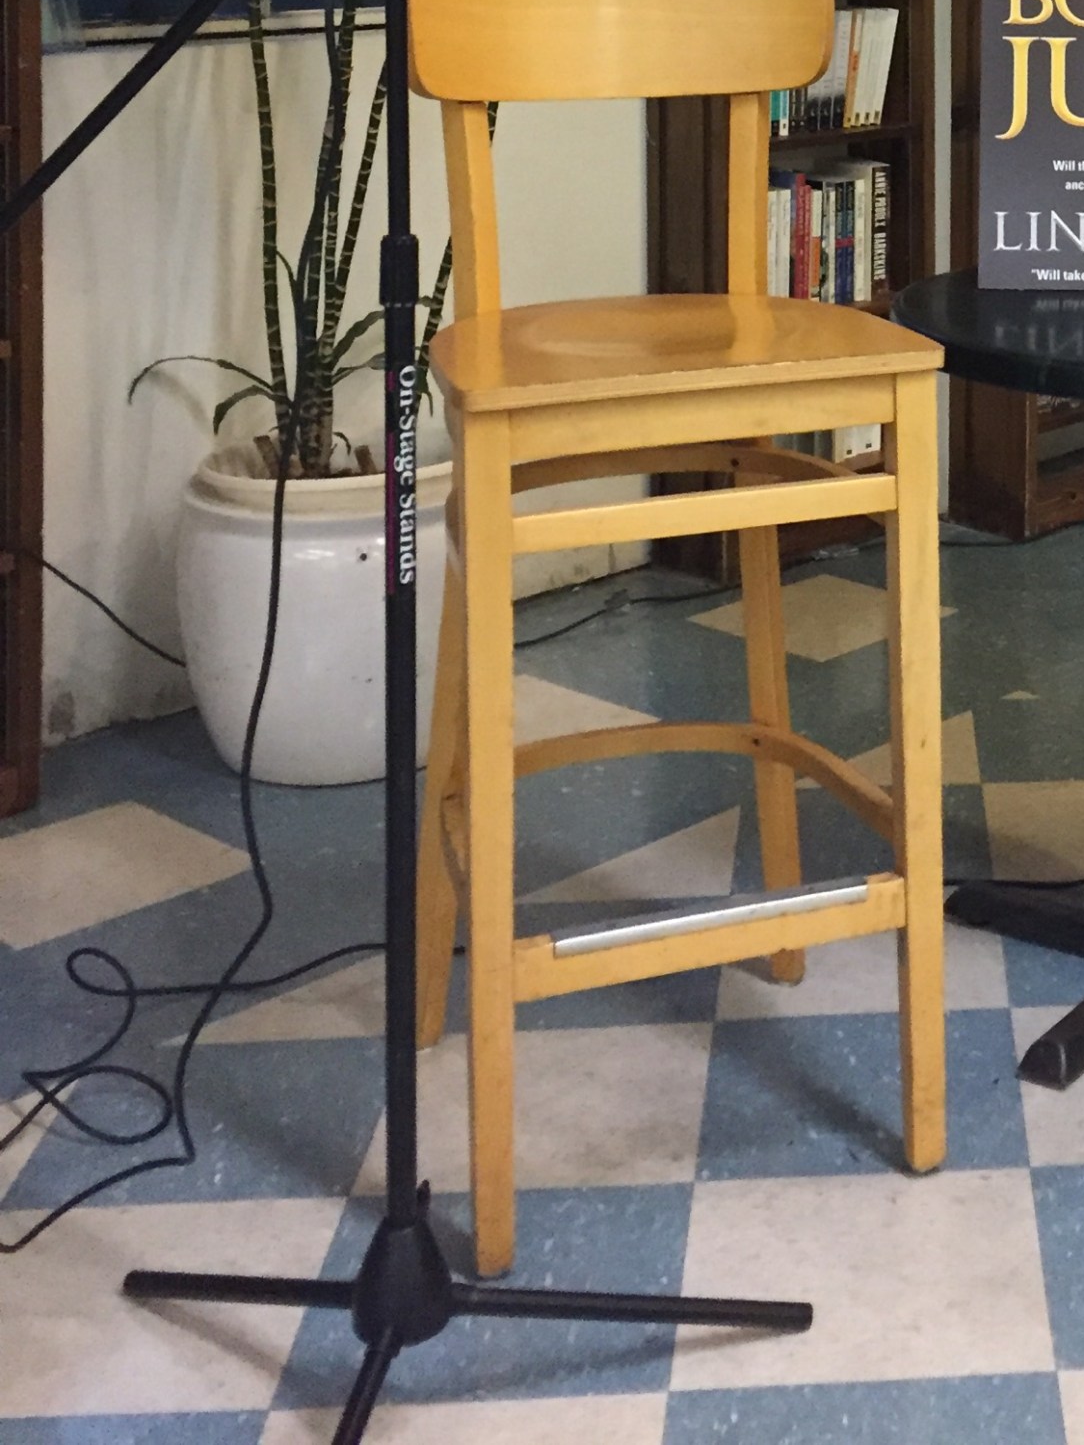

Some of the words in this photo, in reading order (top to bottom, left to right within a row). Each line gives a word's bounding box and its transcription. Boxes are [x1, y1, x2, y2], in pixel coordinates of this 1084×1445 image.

[873, 171, 887, 196] ANNIE
[1053, 160, 1076, 172] Will
[874, 196, 887, 228] PROULX
[873, 232, 887, 281] BARKSKINS
[393, 365, 417, 486] On-Stage
[399, 492, 417, 584] Stands
